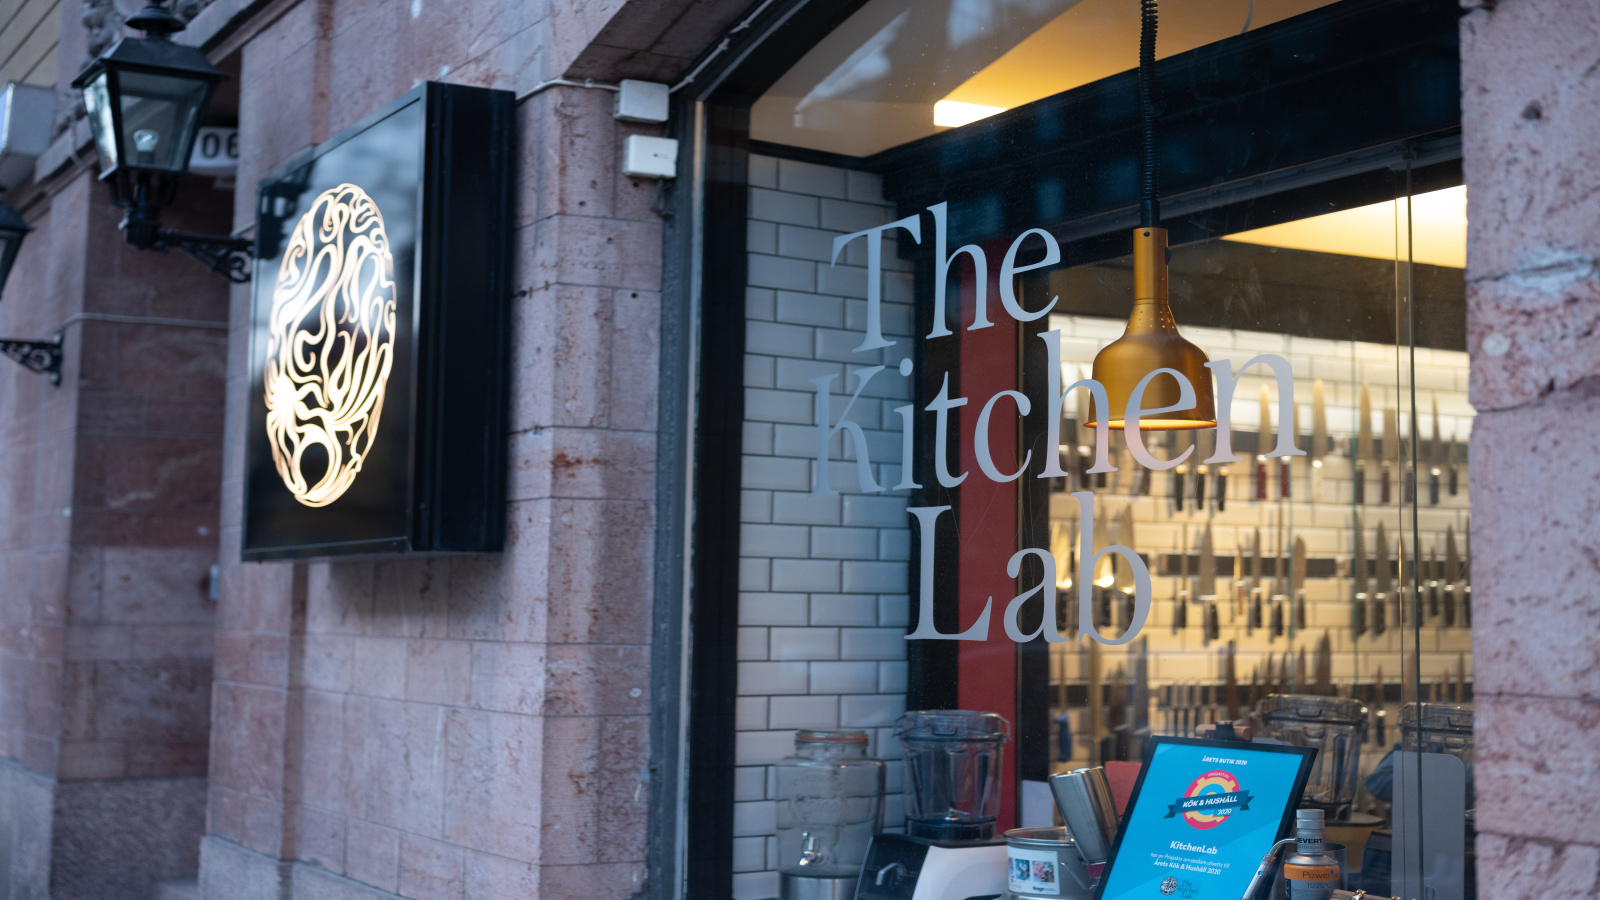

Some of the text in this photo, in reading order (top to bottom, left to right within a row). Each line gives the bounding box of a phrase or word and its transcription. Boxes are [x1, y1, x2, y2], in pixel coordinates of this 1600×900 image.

[831, 201, 1061, 353] The
[807, 328, 1307, 498] Kitchen
[903, 490, 1153, 646] Lab
[1202, 755, 1219, 763] ÅRETS
[1182, 799, 1198, 808] KÖK
[1205, 795, 1238, 805] HUSHÅLL
[1217, 808, 1232, 816] 2020
[1170, 840, 1218, 855] KitchenLab
[1153, 858, 1168, 867] Årets
[1168, 861, 1180, 869] Kök
[1207, 867, 1222, 875] 2020
